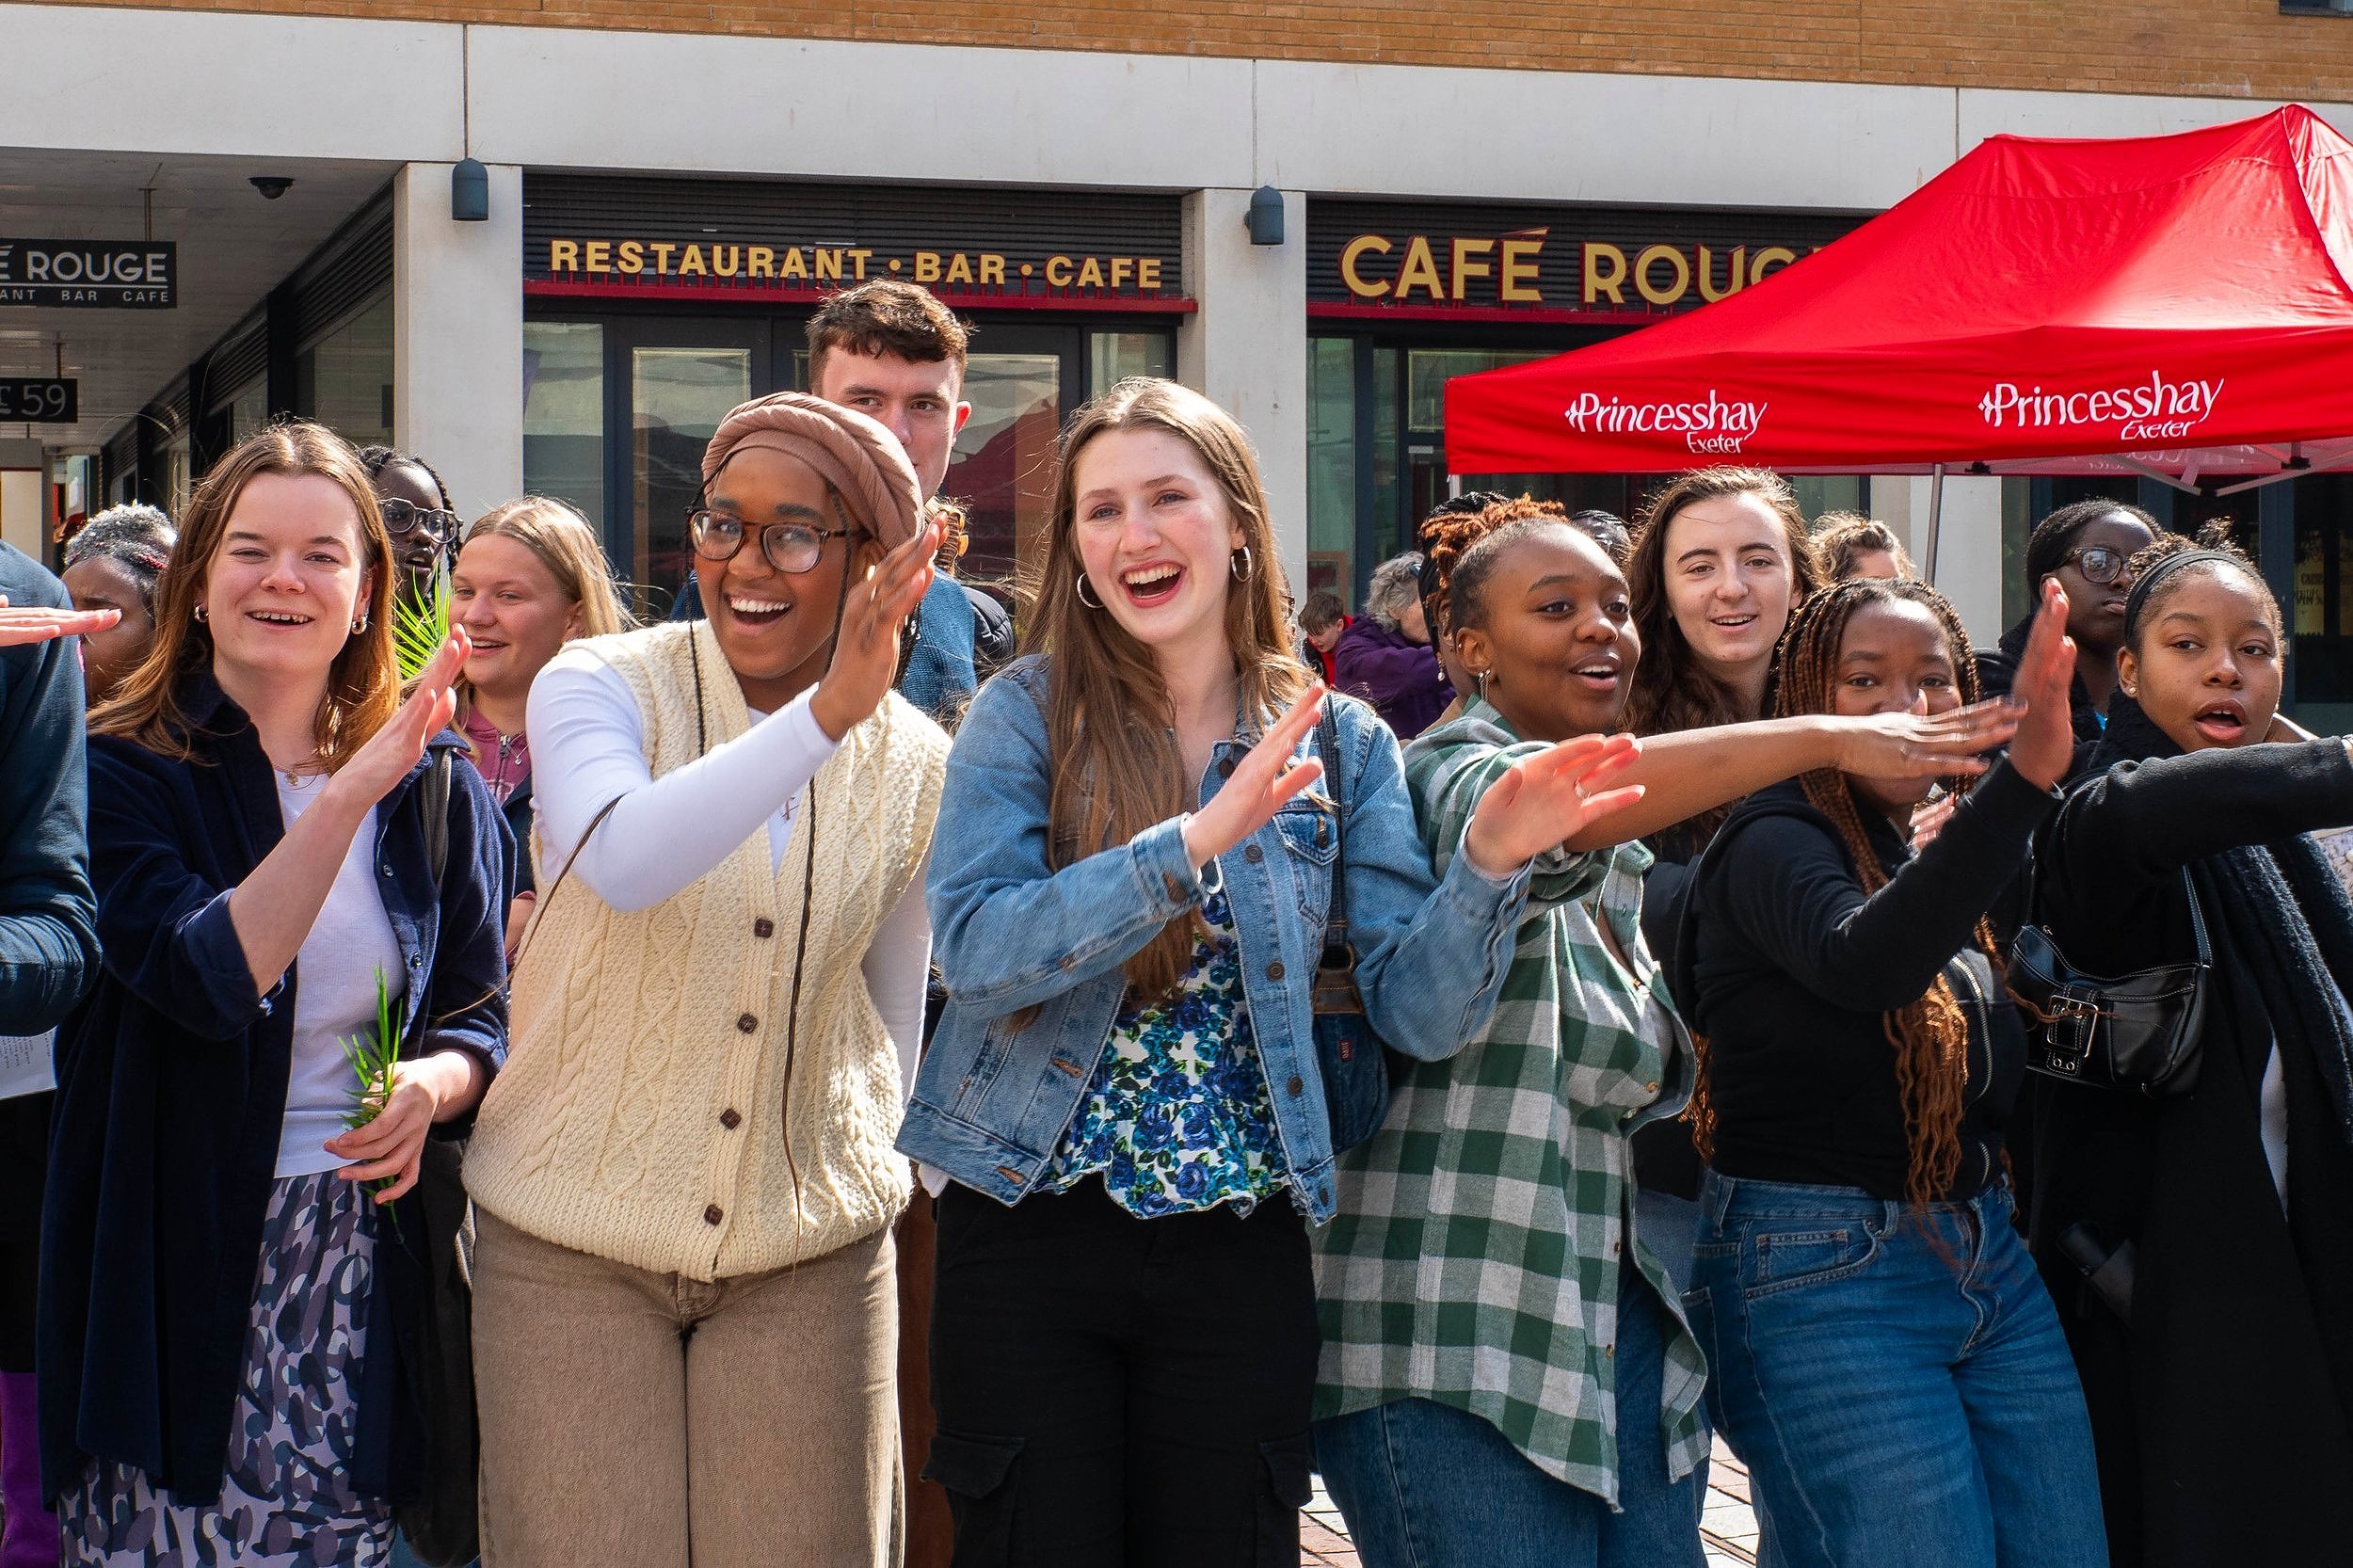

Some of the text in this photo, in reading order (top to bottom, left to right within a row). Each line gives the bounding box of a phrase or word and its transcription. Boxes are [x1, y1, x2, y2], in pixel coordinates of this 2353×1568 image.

[25, 250, 168, 282] ROUGE
[551, 239, 1161, 288] RESTAURANT BAR CAFE
[1339, 227, 1549, 302] CAFÉ
[61, 290, 98, 301] BAR
[122, 291, 168, 302] CAFE
[21, 384, 66, 417] 59
[1577, 389, 1768, 440] Princesshay
[1993, 369, 2224, 427] Princesshay
[1686, 431, 1743, 454] Exeter
[2121, 420, 2196, 440] Exeter
